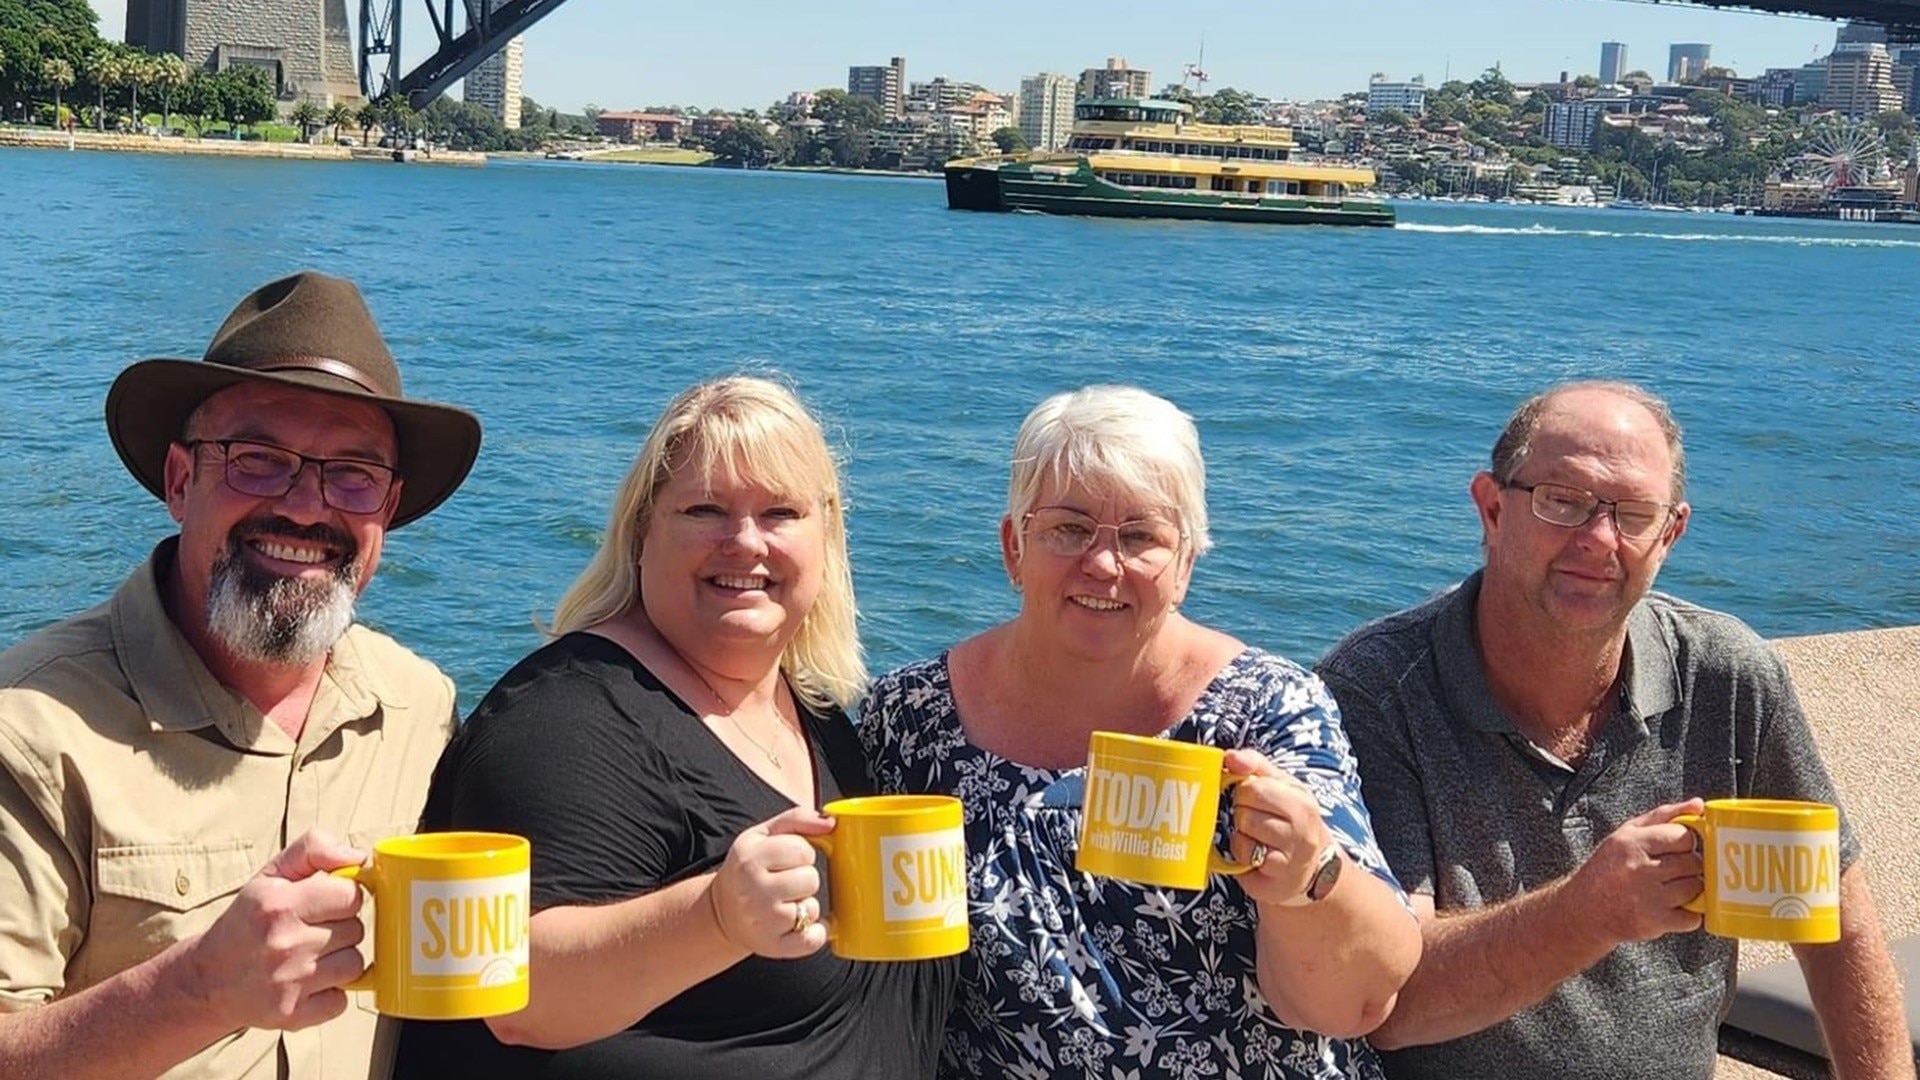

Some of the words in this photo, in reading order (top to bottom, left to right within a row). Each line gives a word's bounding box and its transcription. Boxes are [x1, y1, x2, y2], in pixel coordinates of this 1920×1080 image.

[1093, 769, 1201, 836] TODAY
[1112, 829, 1151, 856] Willie
[1151, 835, 1188, 862] Geist
